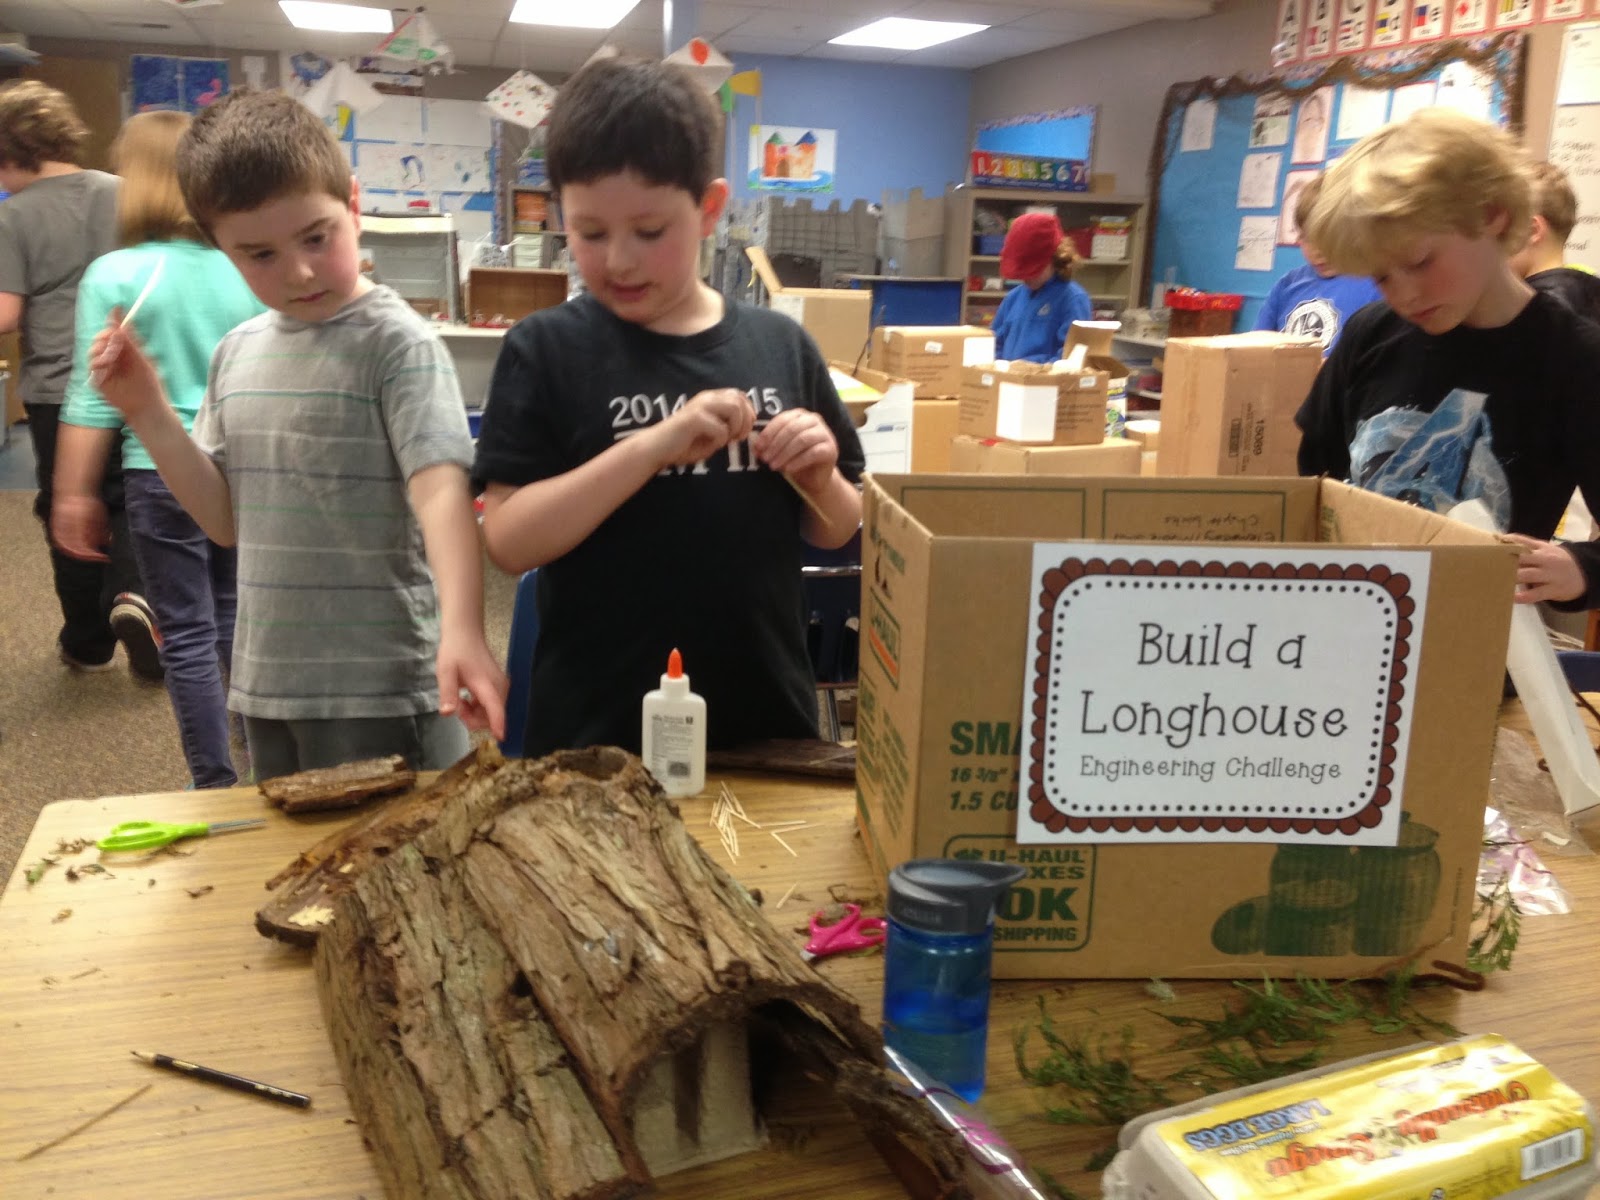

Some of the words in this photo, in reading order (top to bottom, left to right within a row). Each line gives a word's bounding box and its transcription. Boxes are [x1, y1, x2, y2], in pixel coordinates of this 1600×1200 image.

[1137, 622, 1257, 669] Build
[1276, 634, 1306, 669] a
[1081, 690, 1348, 749] Longhouse
[1080, 755, 1215, 783] Engineering
[1225, 756, 1342, 784] Challenge
[950, 790, 983, 811] 1.5
[1028, 866, 1085, 879] XES
[996, 886, 1079, 921] OK
[994, 927, 1077, 941] SHIPPING
[1248, 1098, 1333, 1134] LARGE
[1184, 1118, 1255, 1152] EGGS
